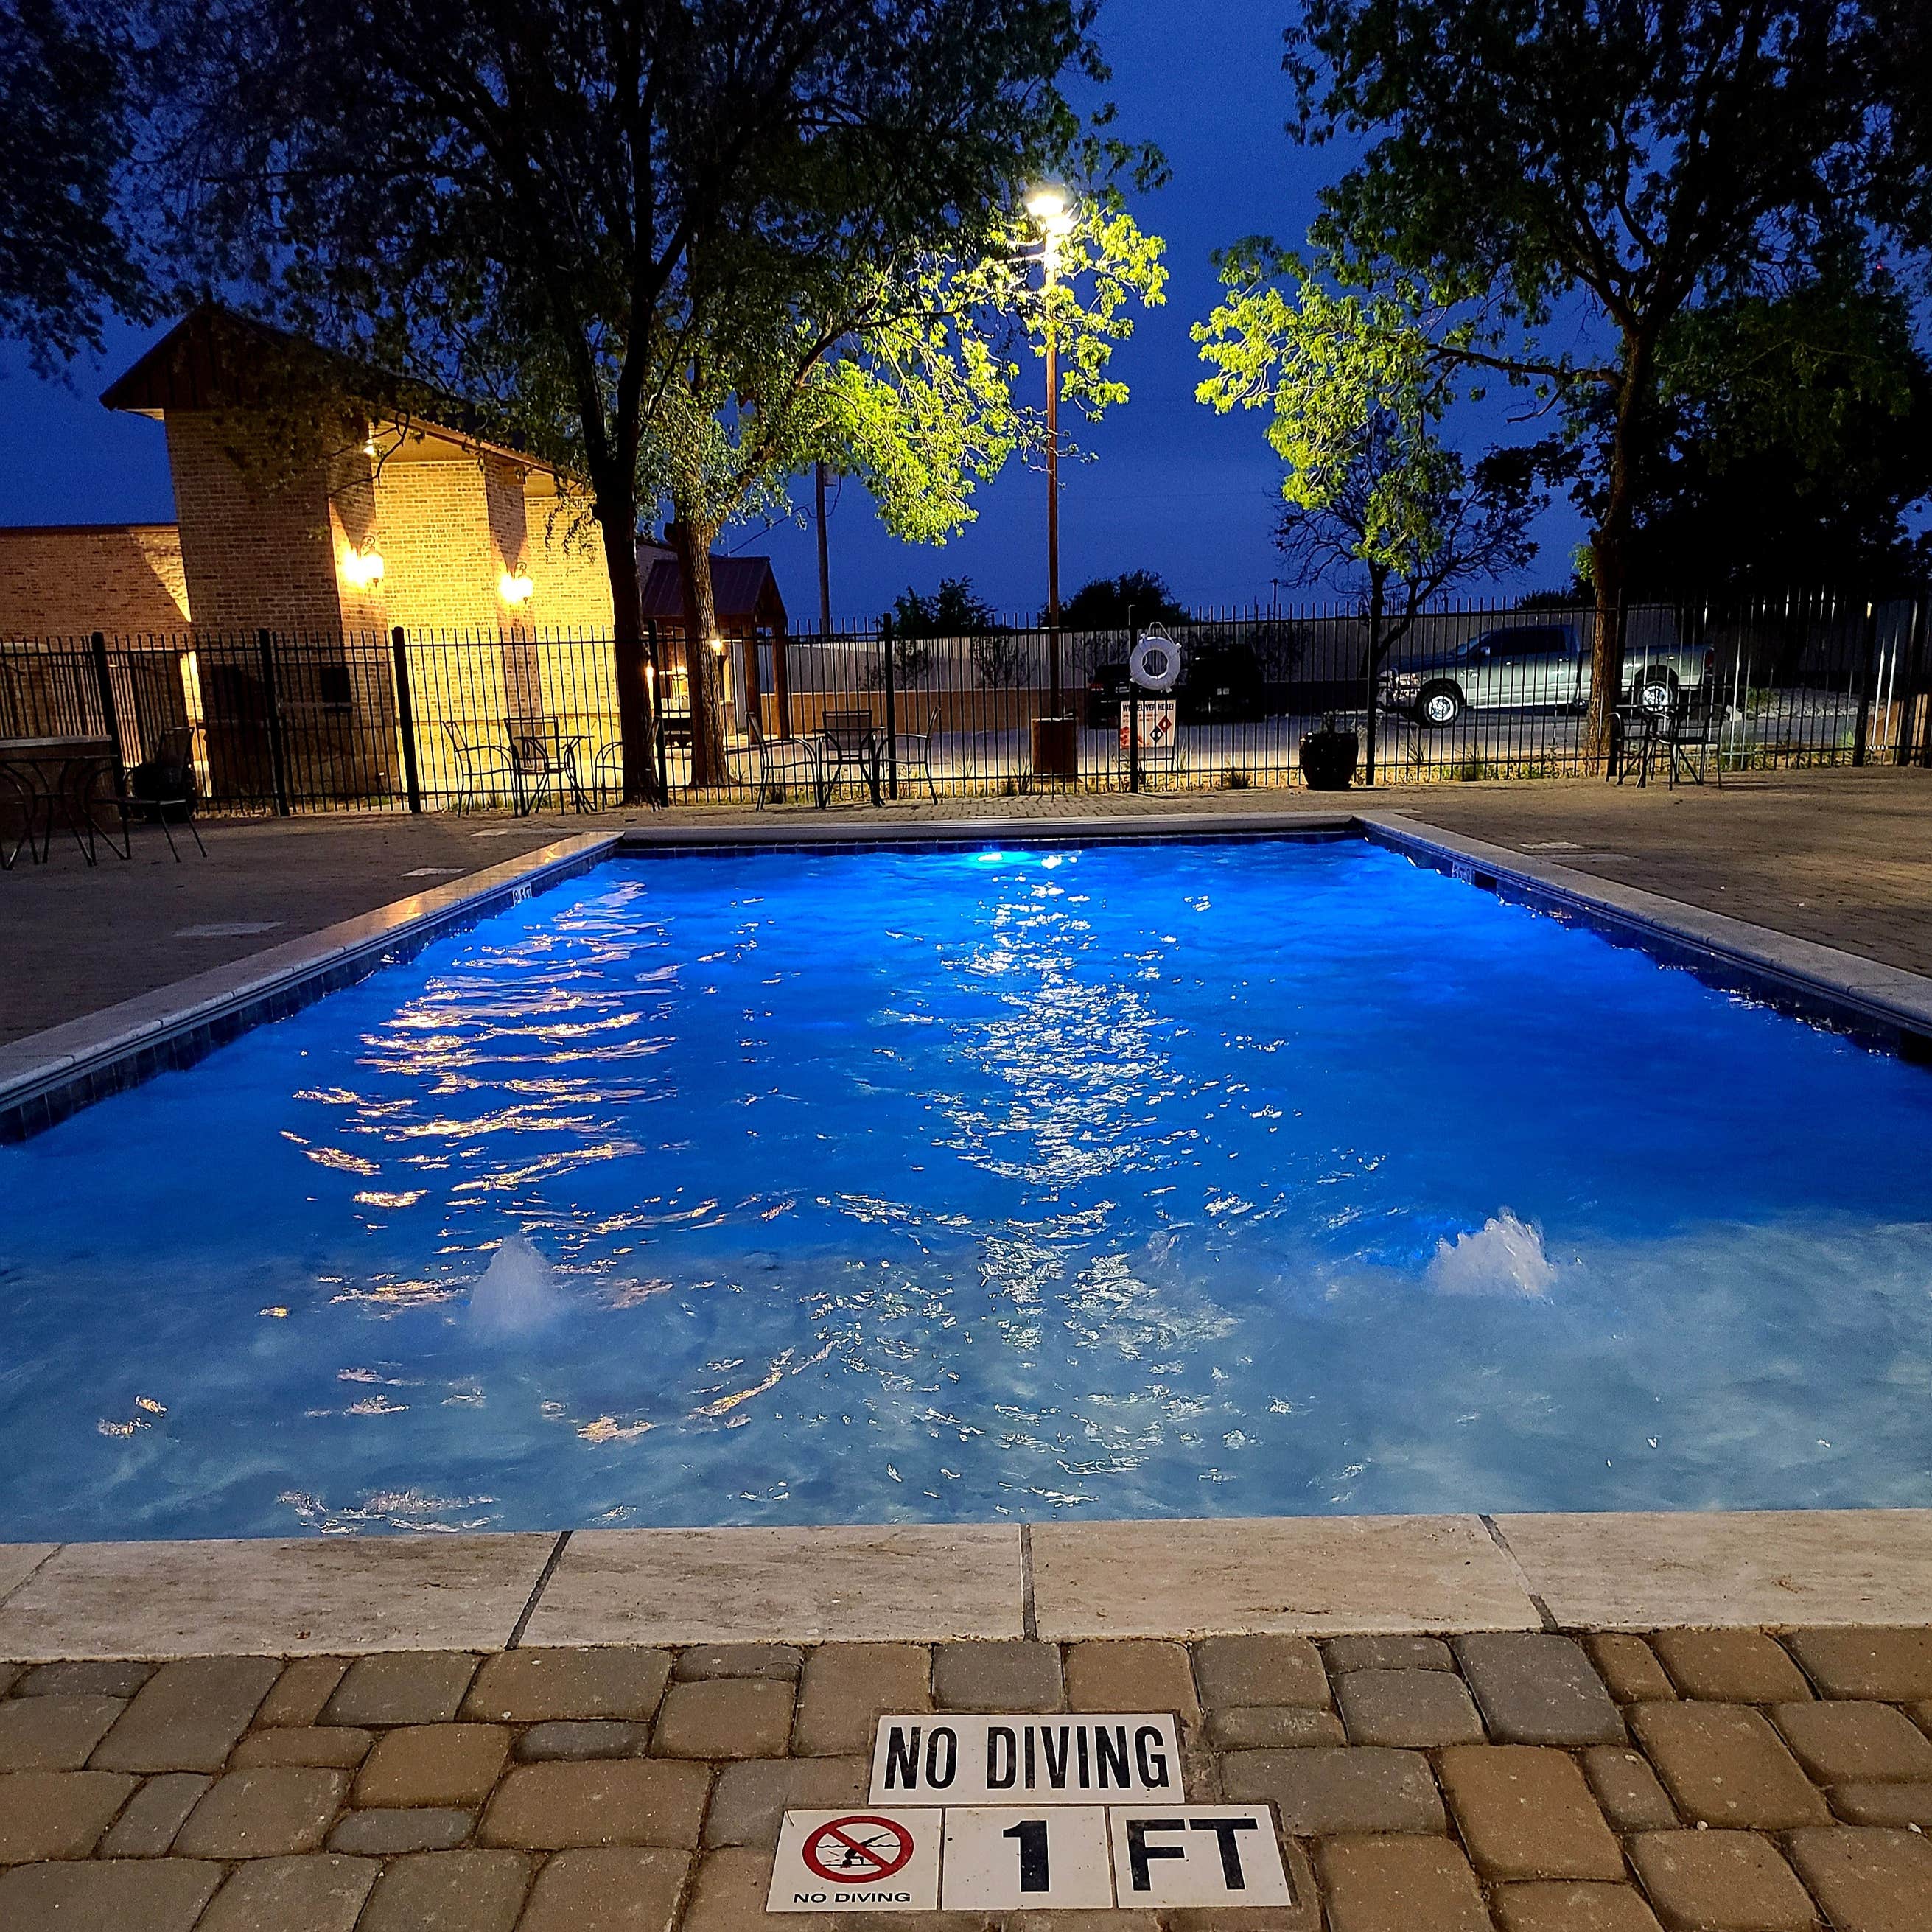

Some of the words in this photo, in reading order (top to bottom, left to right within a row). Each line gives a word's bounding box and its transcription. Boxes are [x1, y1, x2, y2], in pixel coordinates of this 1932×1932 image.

[884, 1726, 958, 1789] NO
[987, 1726, 1170, 1789] DIVING
[1003, 1820, 1050, 1892] 1
[1126, 1818, 1258, 1891] FT
[794, 1893, 827, 1903] NO
[835, 1893, 911, 1903] DIVING
